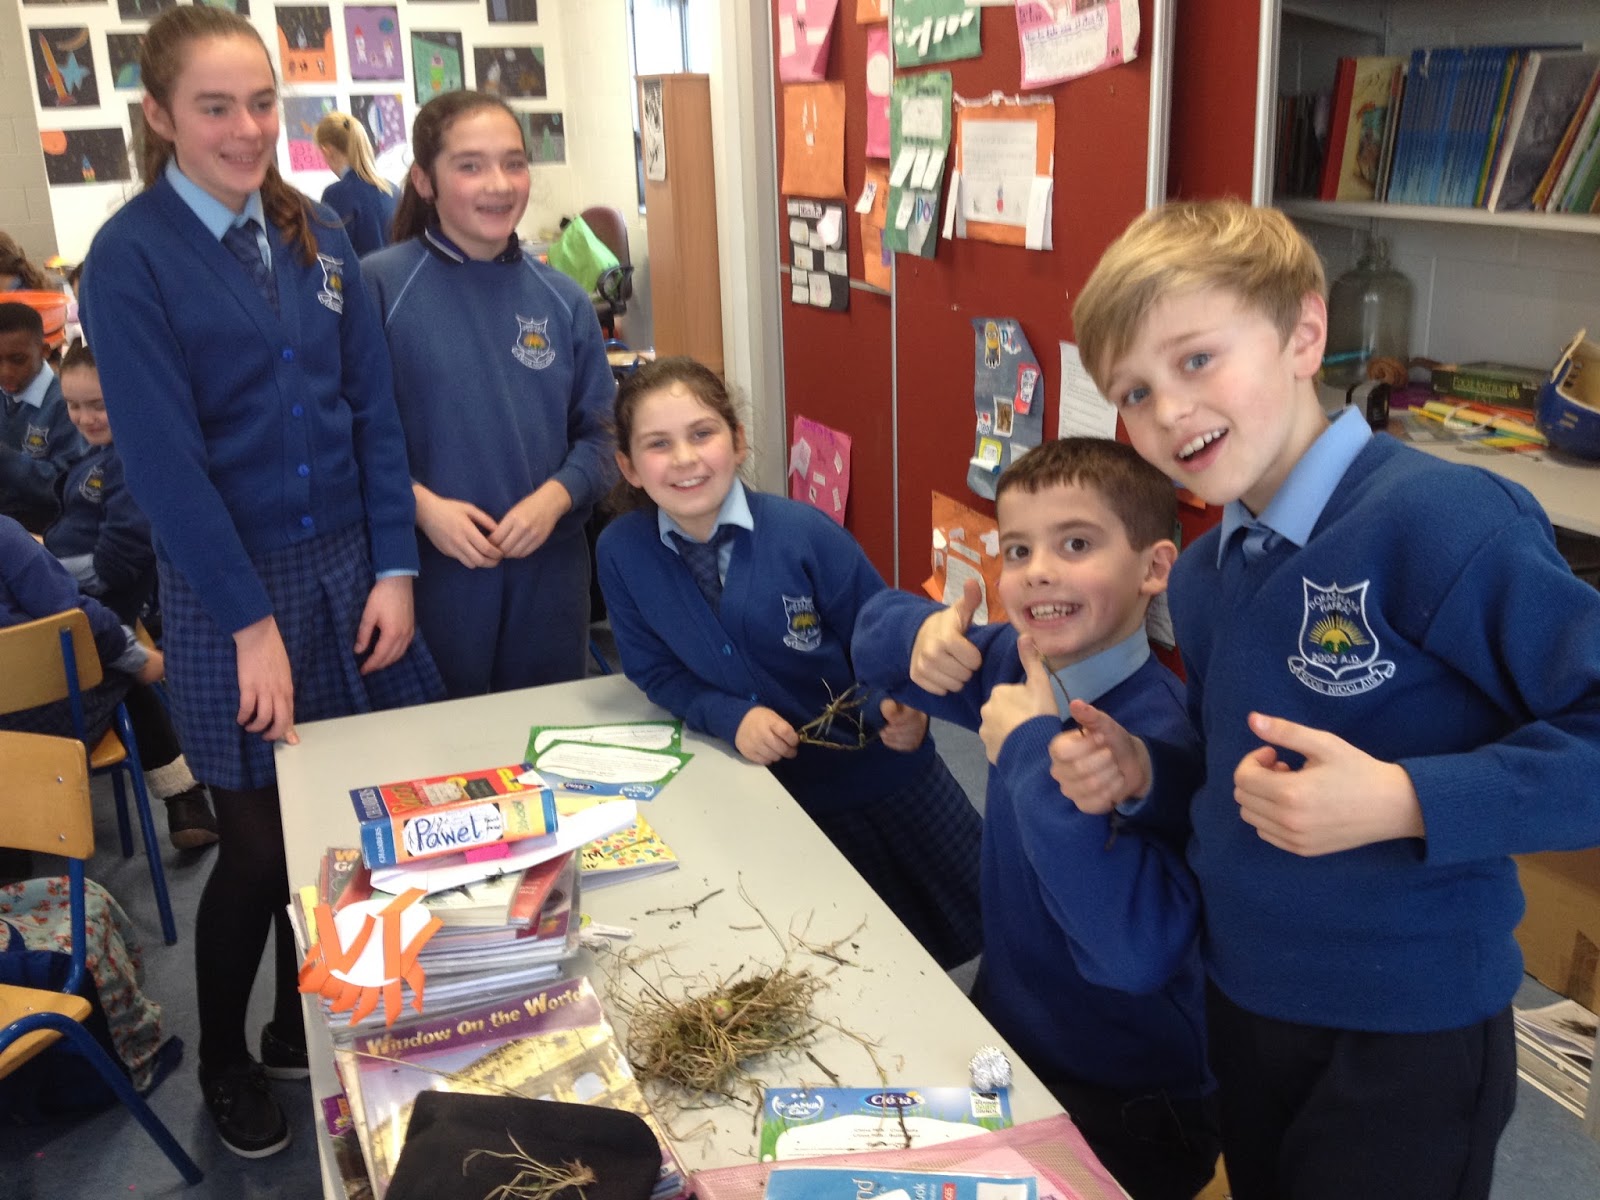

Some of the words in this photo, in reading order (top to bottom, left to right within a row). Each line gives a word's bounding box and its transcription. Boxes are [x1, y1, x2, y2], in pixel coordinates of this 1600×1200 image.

[377, 826, 386, 864] CHAMBERS
[414, 814, 482, 852] Pawel
[366, 1028, 452, 1056] Window
[457, 1018, 486, 1036] On
[490, 1010, 522, 1028] the
[524, 985, 586, 1018] World
